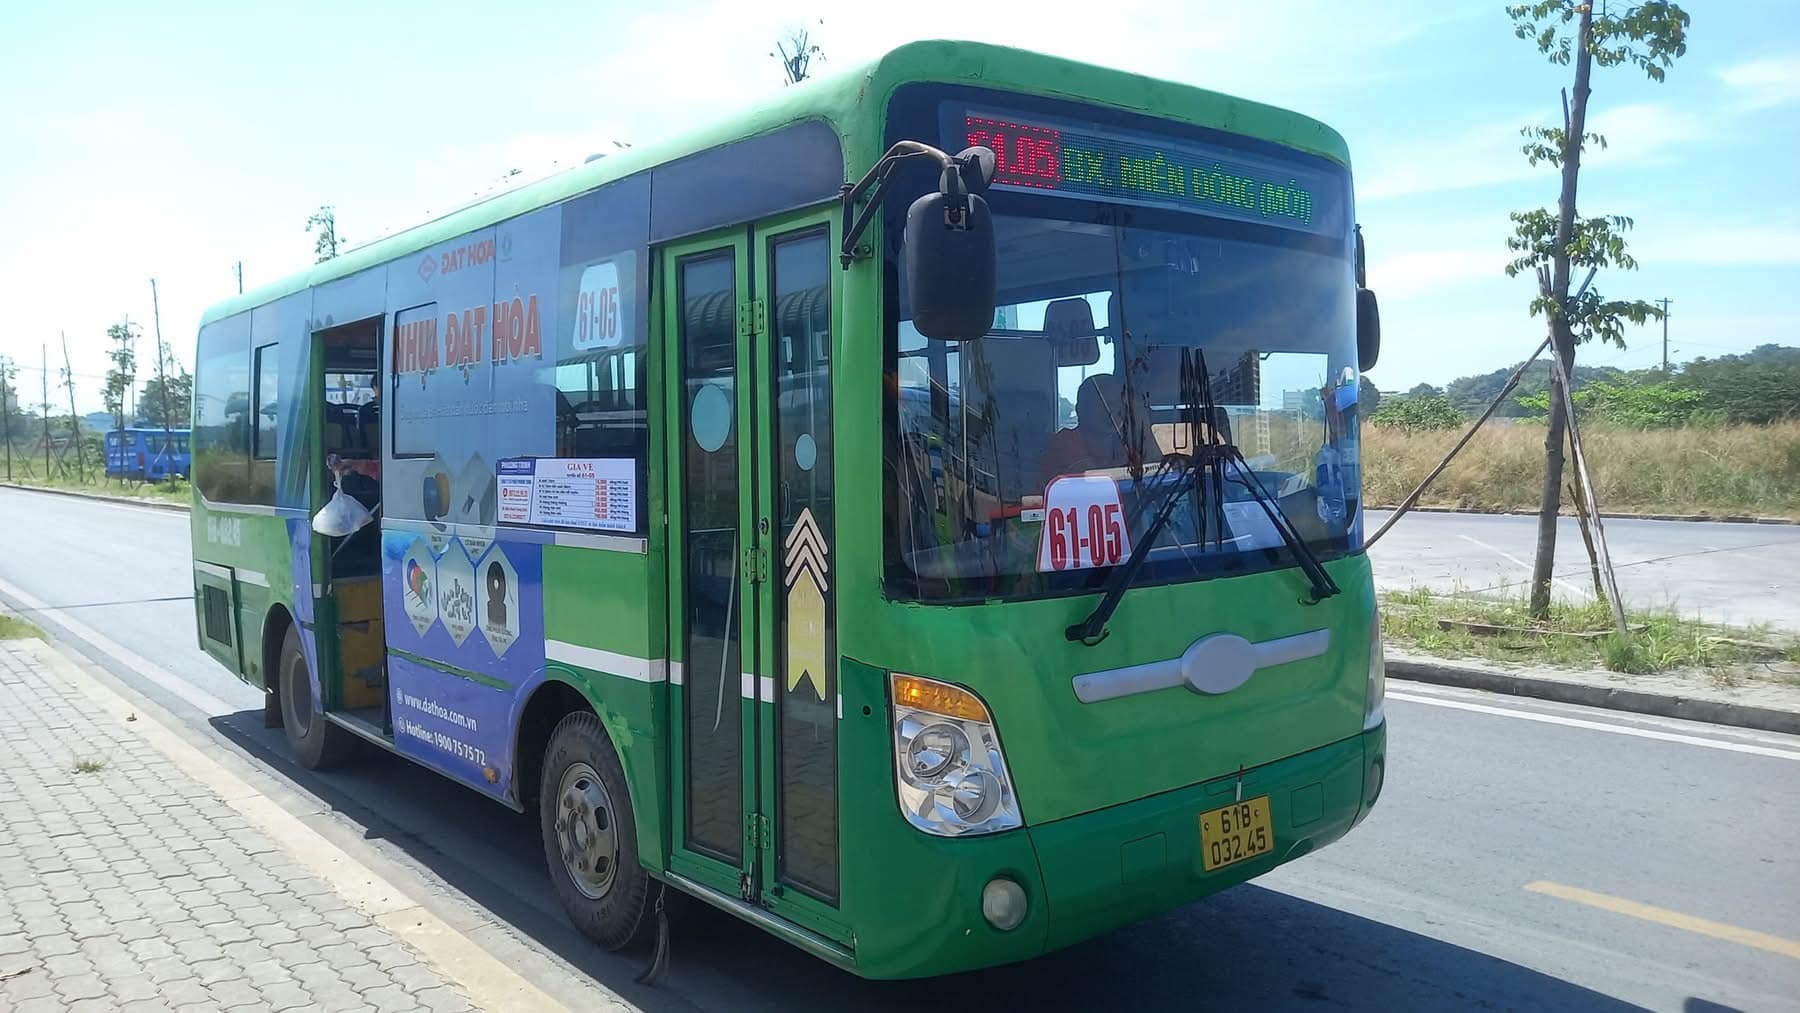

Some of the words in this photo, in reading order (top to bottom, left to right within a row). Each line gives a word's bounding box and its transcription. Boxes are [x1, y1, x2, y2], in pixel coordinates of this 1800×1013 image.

[579, 287, 617, 342] 61-05
[1049, 504, 1122, 571] 61-05
[404, 694, 477, 732] www.dathoa.com.vn
[406, 719, 433, 744] Hotline:
[434, 731, 452, 753] 1900
[1221, 804, 1251, 834] 61B
[1211, 826, 1266, 866] 032.45
